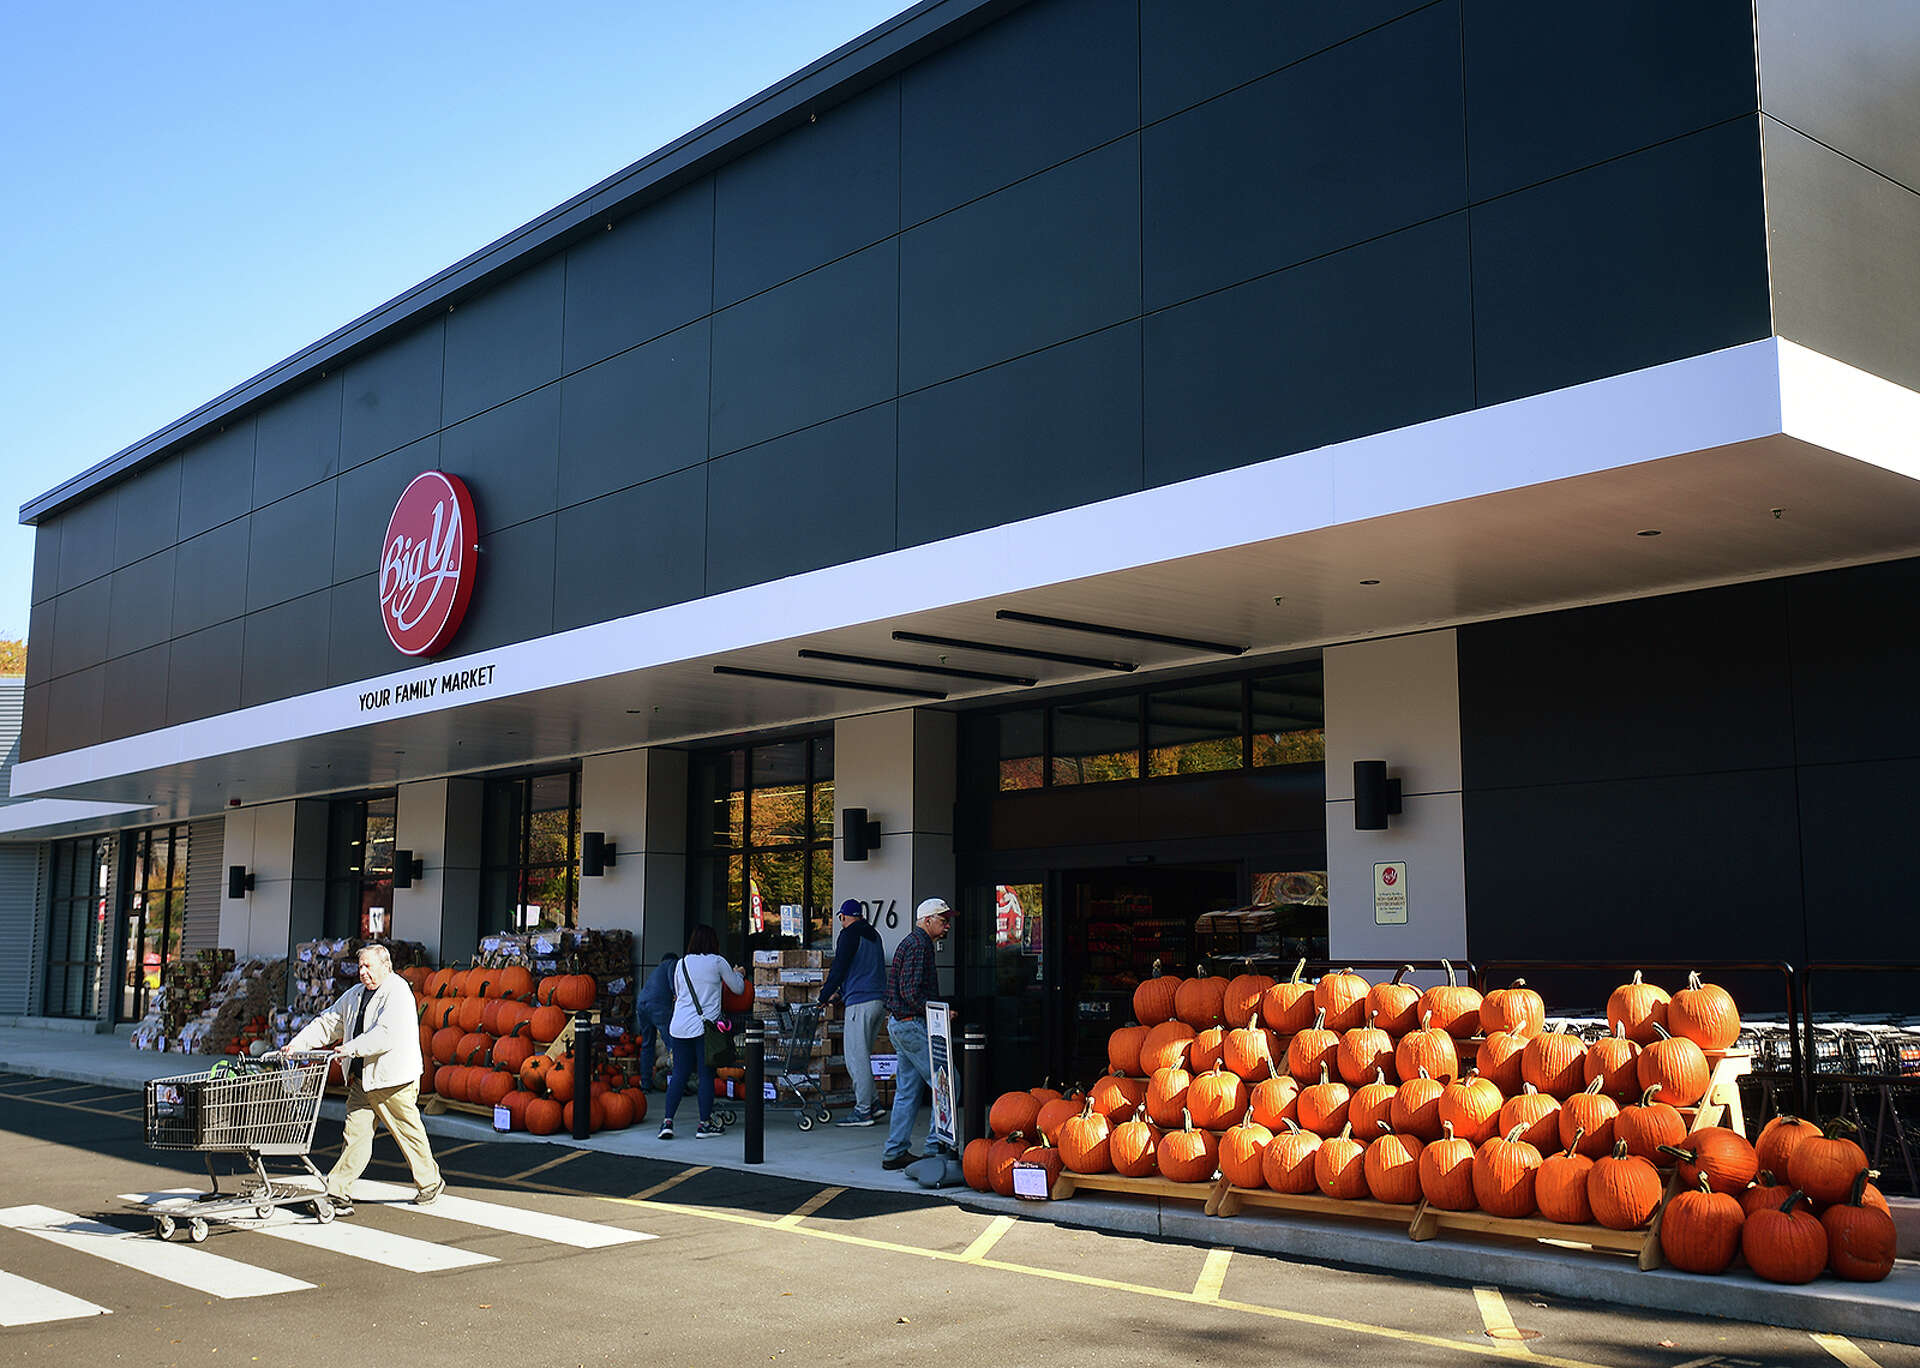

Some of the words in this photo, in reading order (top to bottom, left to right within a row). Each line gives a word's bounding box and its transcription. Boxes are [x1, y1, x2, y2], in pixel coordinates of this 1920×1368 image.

[380, 534, 428, 618] Big
[359, 688, 391, 711] YOUR
[395, 677, 437, 704] FAMILY
[441, 665, 496, 694] MARKET
